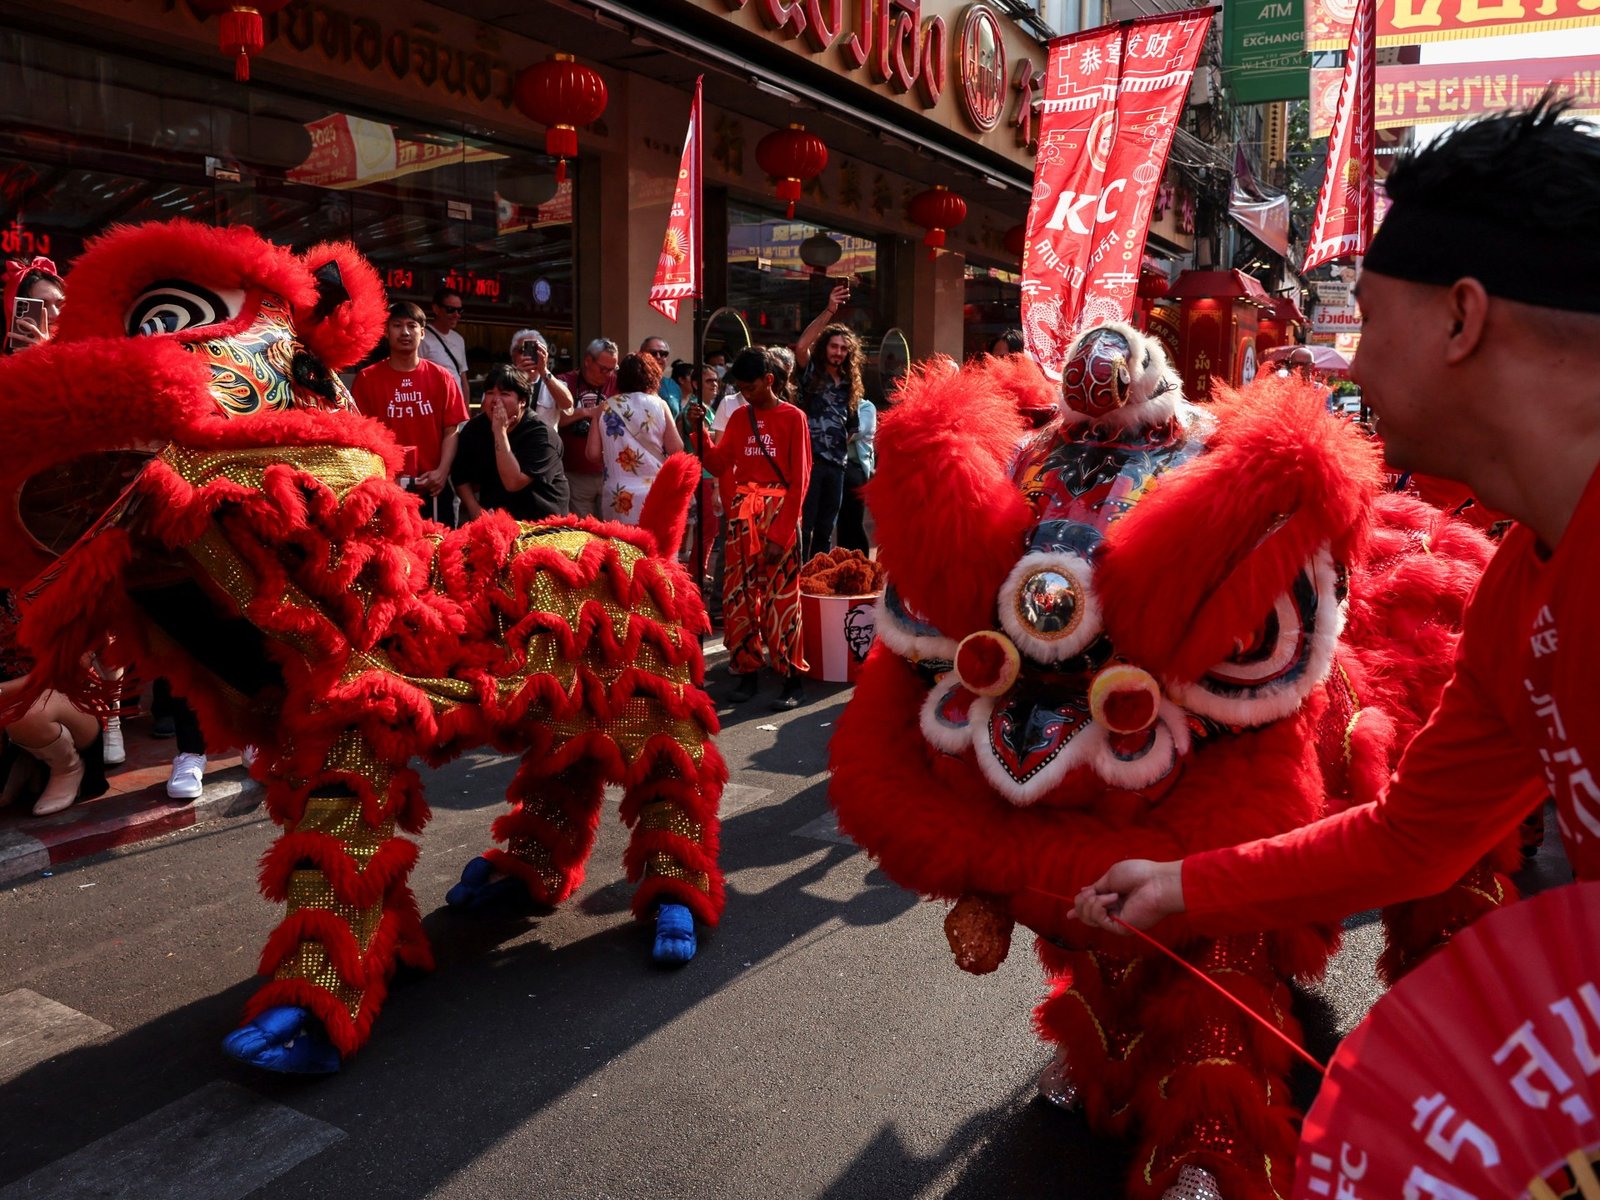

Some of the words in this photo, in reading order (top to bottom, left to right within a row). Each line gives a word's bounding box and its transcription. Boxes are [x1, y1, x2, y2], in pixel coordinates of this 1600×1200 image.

[1257, 2, 1292, 20] ATM
[1044, 177, 1128, 235] KC
[1530, 628, 1559, 658] KF
[1335, 1142, 1368, 1200] FC
